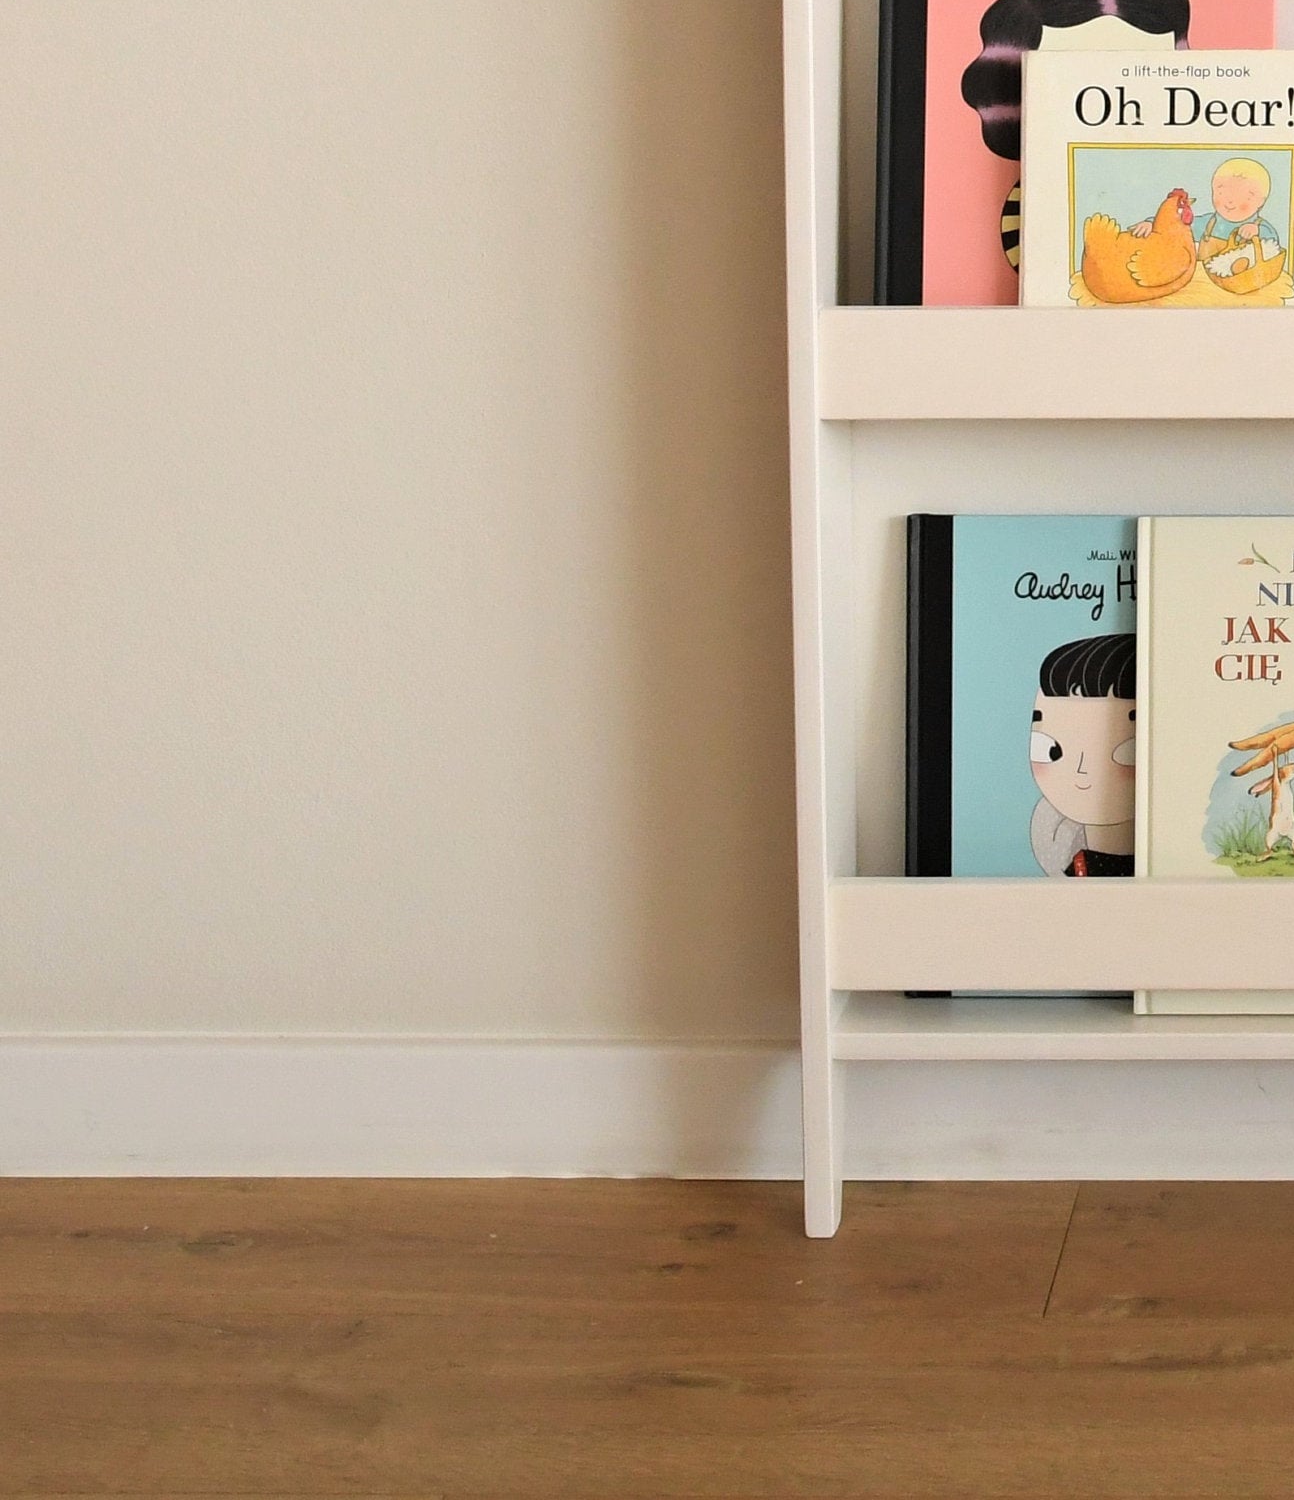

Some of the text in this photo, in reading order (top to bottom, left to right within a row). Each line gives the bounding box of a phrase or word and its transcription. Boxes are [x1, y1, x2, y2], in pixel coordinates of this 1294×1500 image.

[1121, 66, 1251, 79] a lift-the-flap book
[1075, 86, 1294, 127] Oh Dear!
[1087, 550, 1117, 560] Mali
[1014, 571, 1104, 621] Audrey
[1221, 615, 1291, 645] JAK
[1214, 653, 1282, 686] CIĘ
